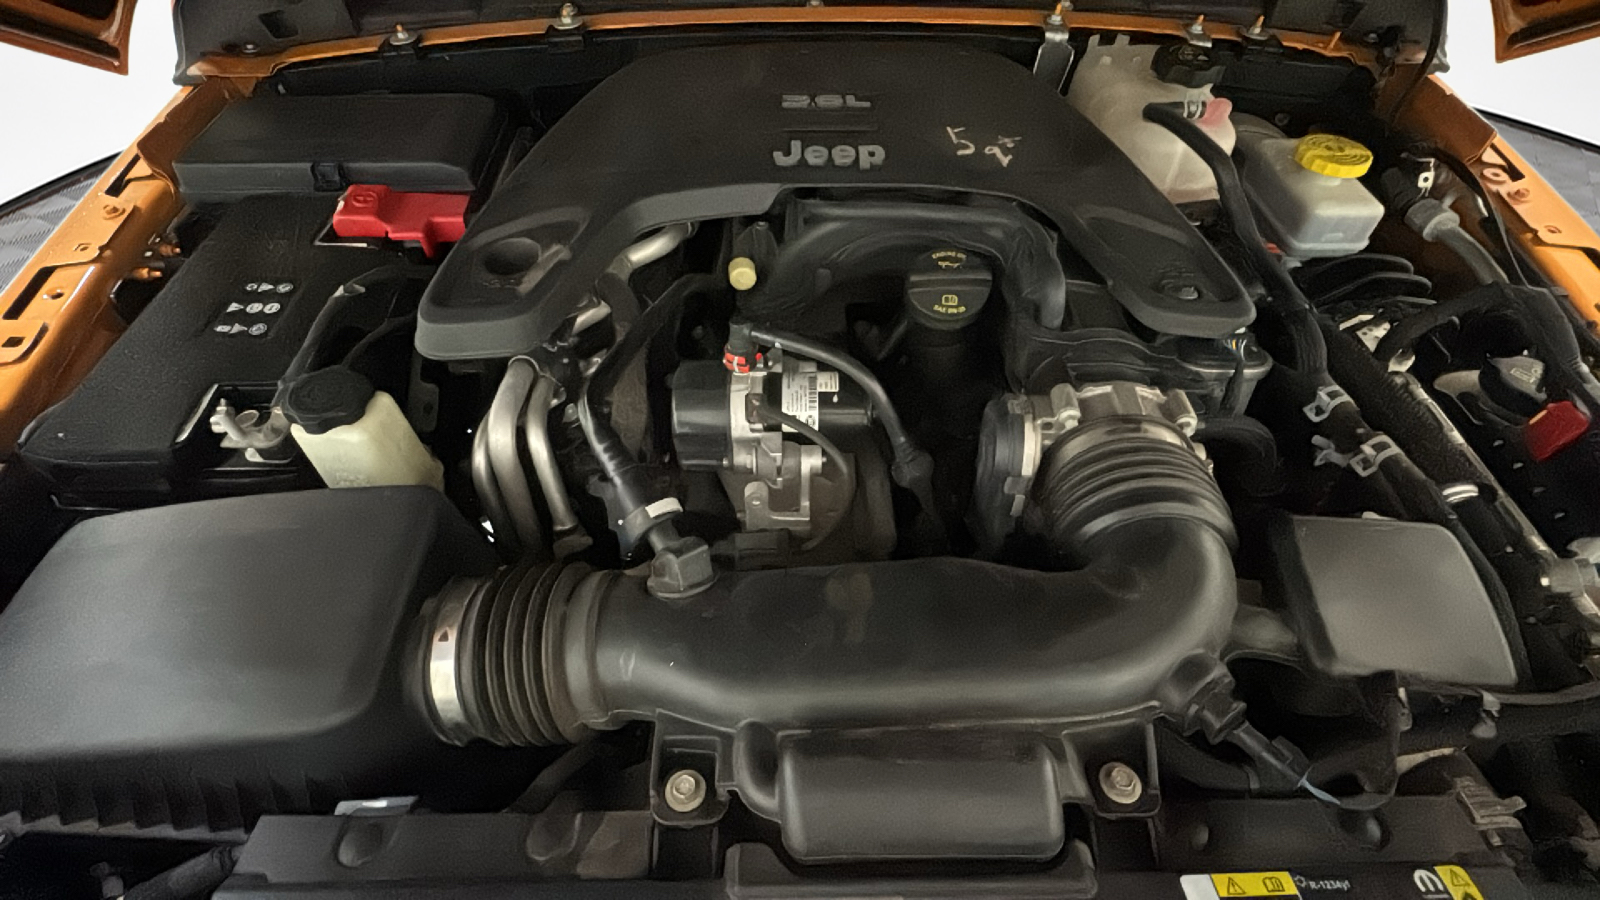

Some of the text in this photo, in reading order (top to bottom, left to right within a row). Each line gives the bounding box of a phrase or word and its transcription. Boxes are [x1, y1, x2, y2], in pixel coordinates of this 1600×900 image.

[781, 94, 872, 109] 3.6L
[772, 139, 886, 170] Jeep
[946, 126, 975, 155] 5
